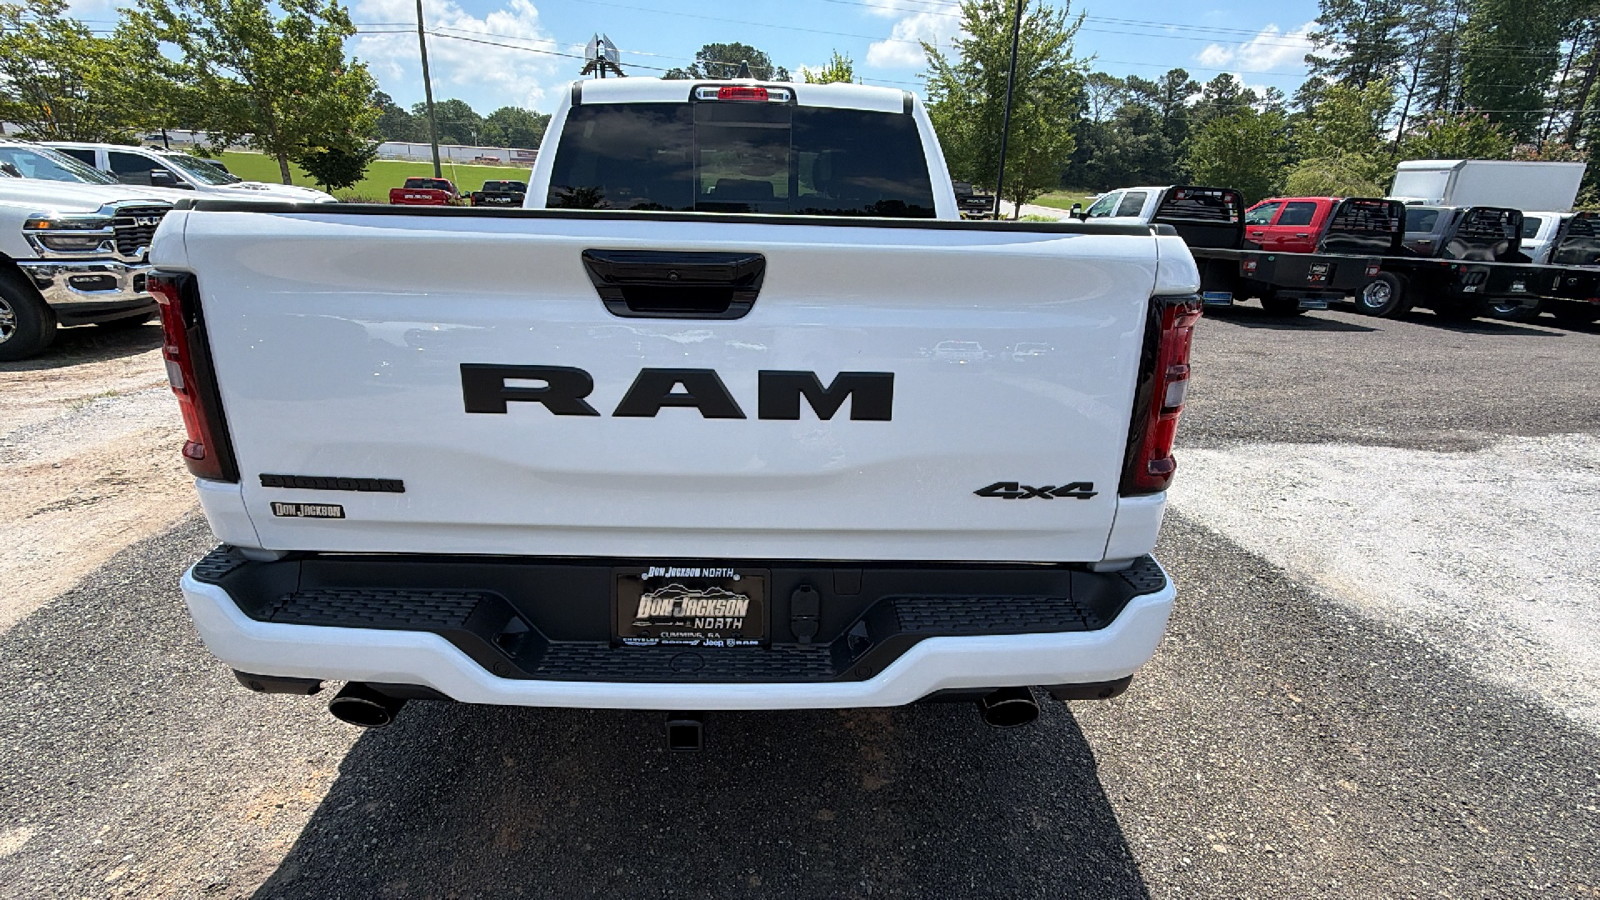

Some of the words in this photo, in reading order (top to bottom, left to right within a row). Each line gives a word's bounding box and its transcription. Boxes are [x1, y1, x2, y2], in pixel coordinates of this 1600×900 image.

[460, 363, 895, 421] RAM
[973, 482, 1098, 500] 4x4
[275, 502, 297, 516] DON
[297, 504, 341, 517] JACKSON
[648, 566, 666, 577] DON
[665, 566, 700, 578] JACKSON
[702, 568, 734, 578] NORTH
[636, 595, 674, 619] DON
[673, 597, 750, 618] JACKSON
[693, 618, 743, 629] NORTH
[703, 638, 724, 647] Jeep
